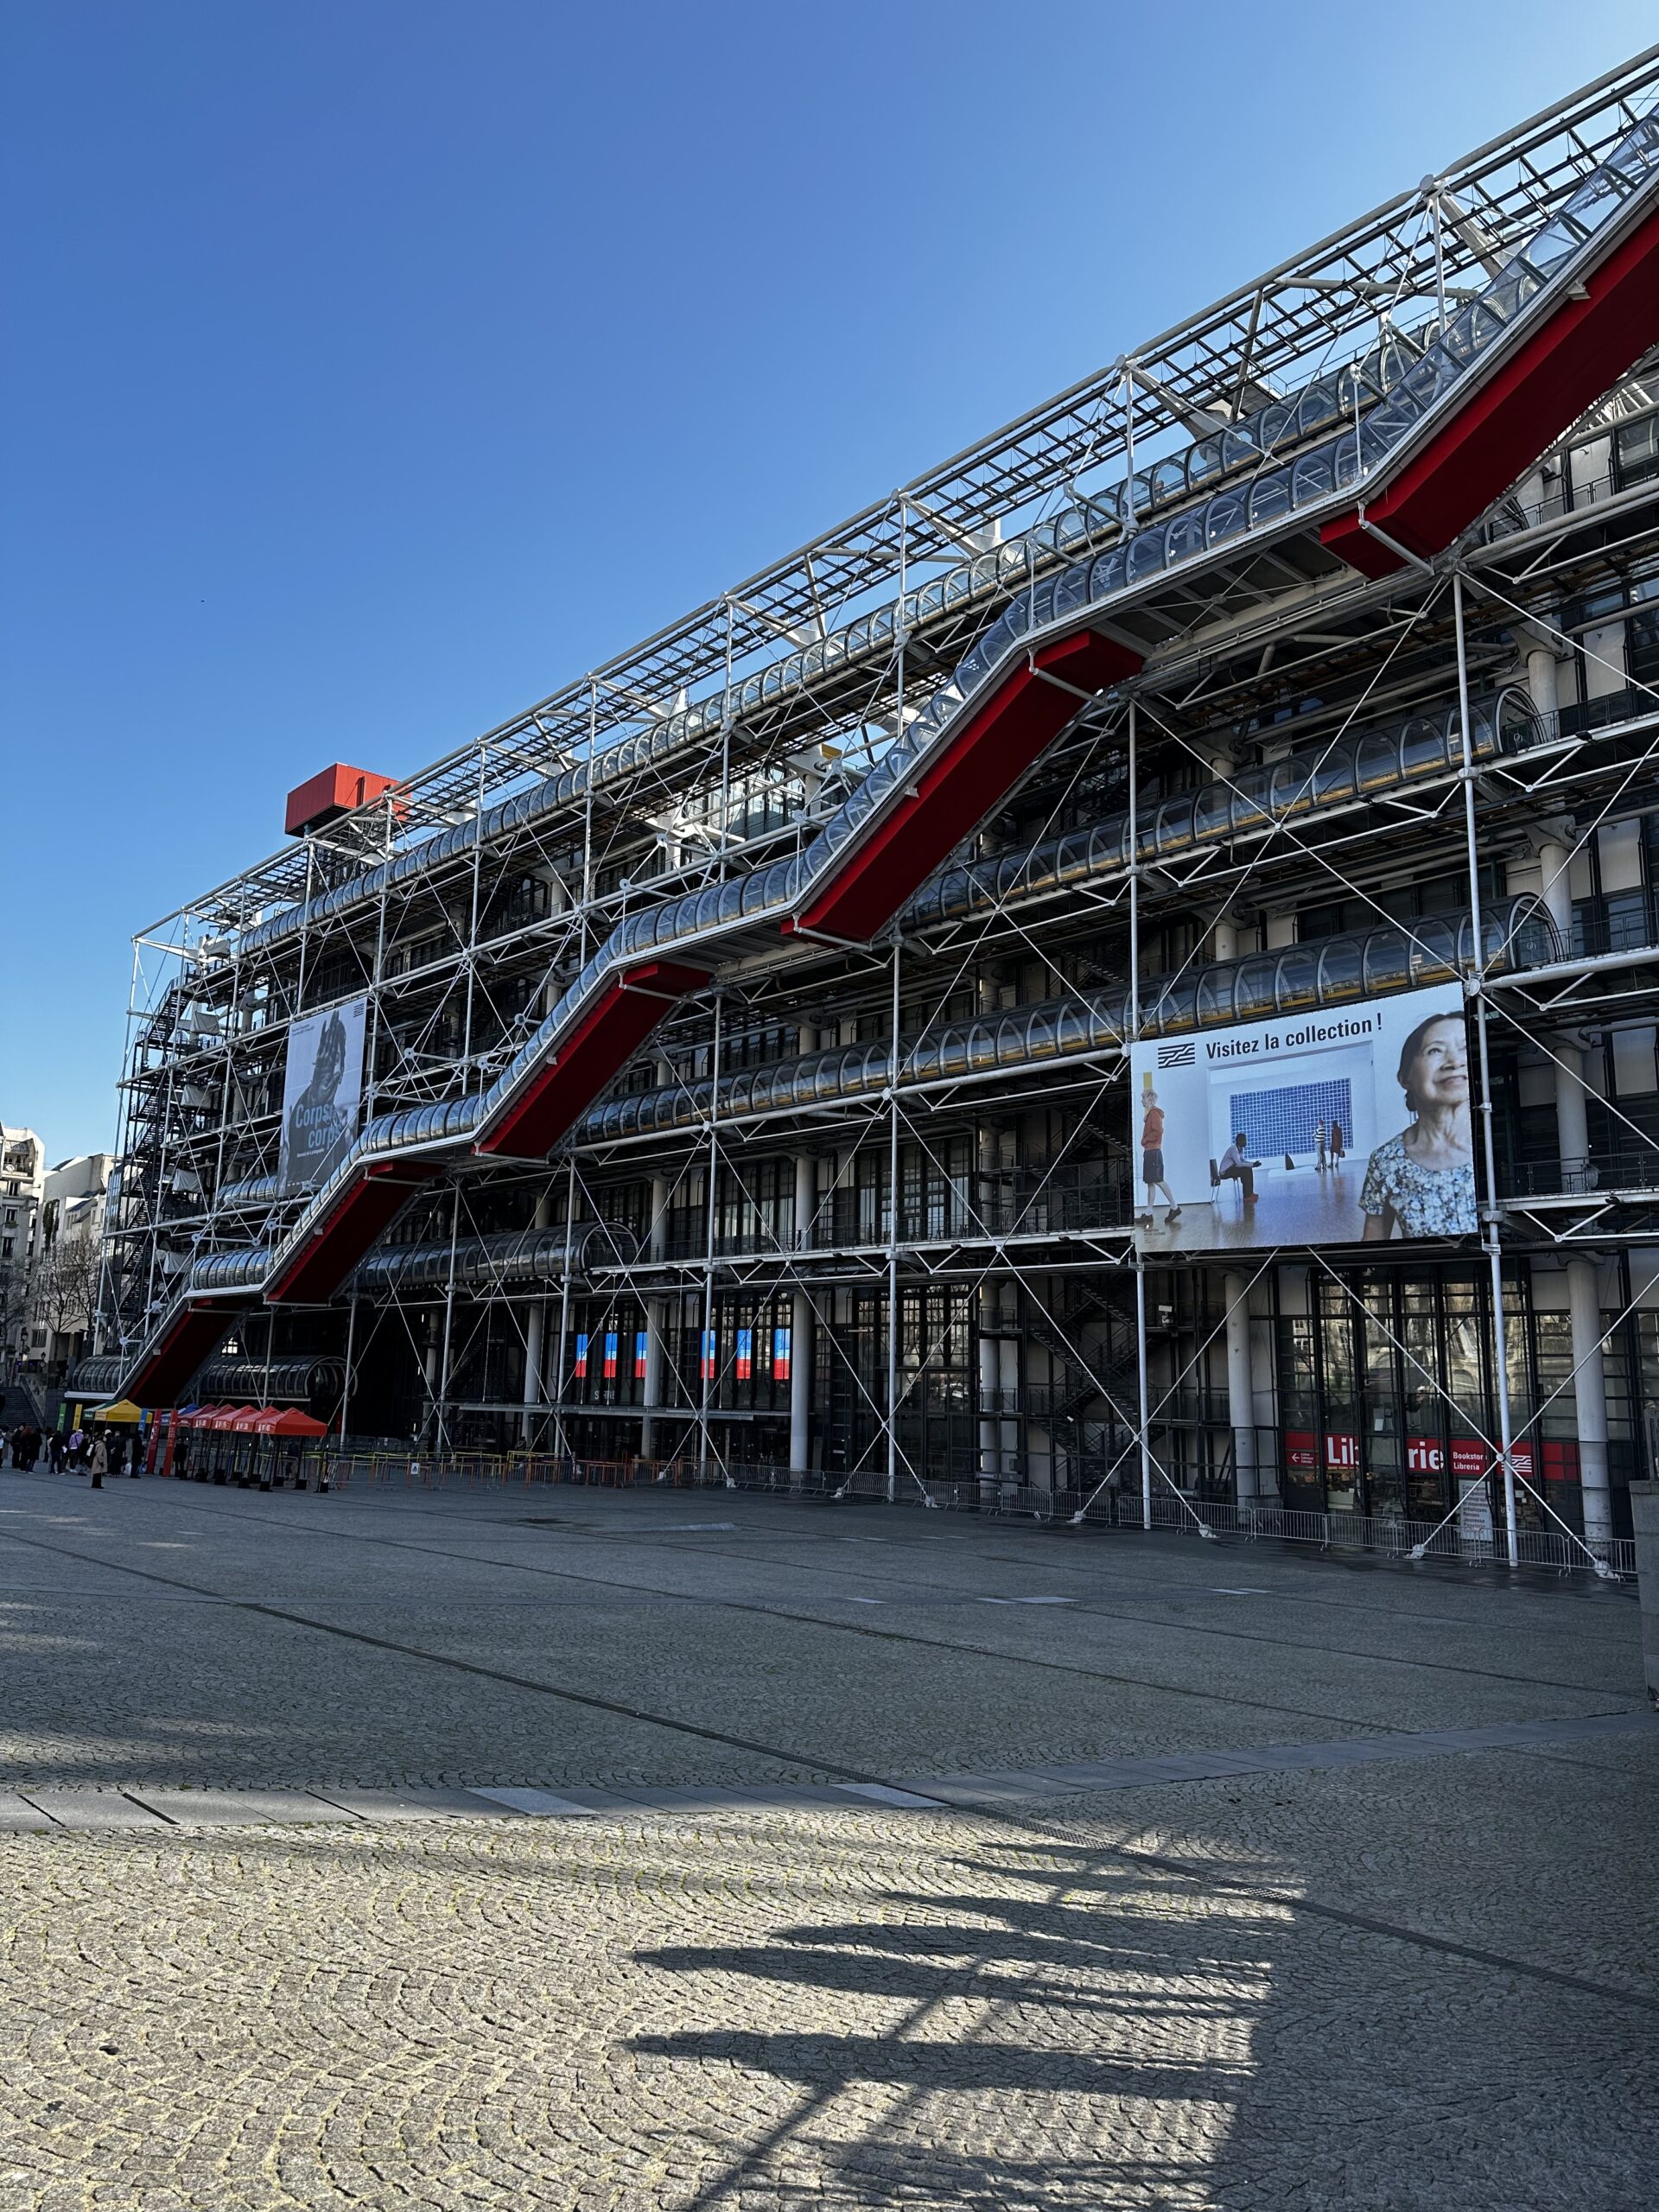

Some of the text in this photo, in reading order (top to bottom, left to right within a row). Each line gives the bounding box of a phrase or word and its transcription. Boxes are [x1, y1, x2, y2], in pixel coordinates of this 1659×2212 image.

[1206, 1039, 1259, 1059] Visitez
[1265, 1033, 1280, 1050] la
[1286, 1019, 1372, 1046] collection
[296, 1103, 330, 1128] Corps
[308, 1122, 342, 1149] corps
[1453, 1462, 1480, 1471] Libreria
